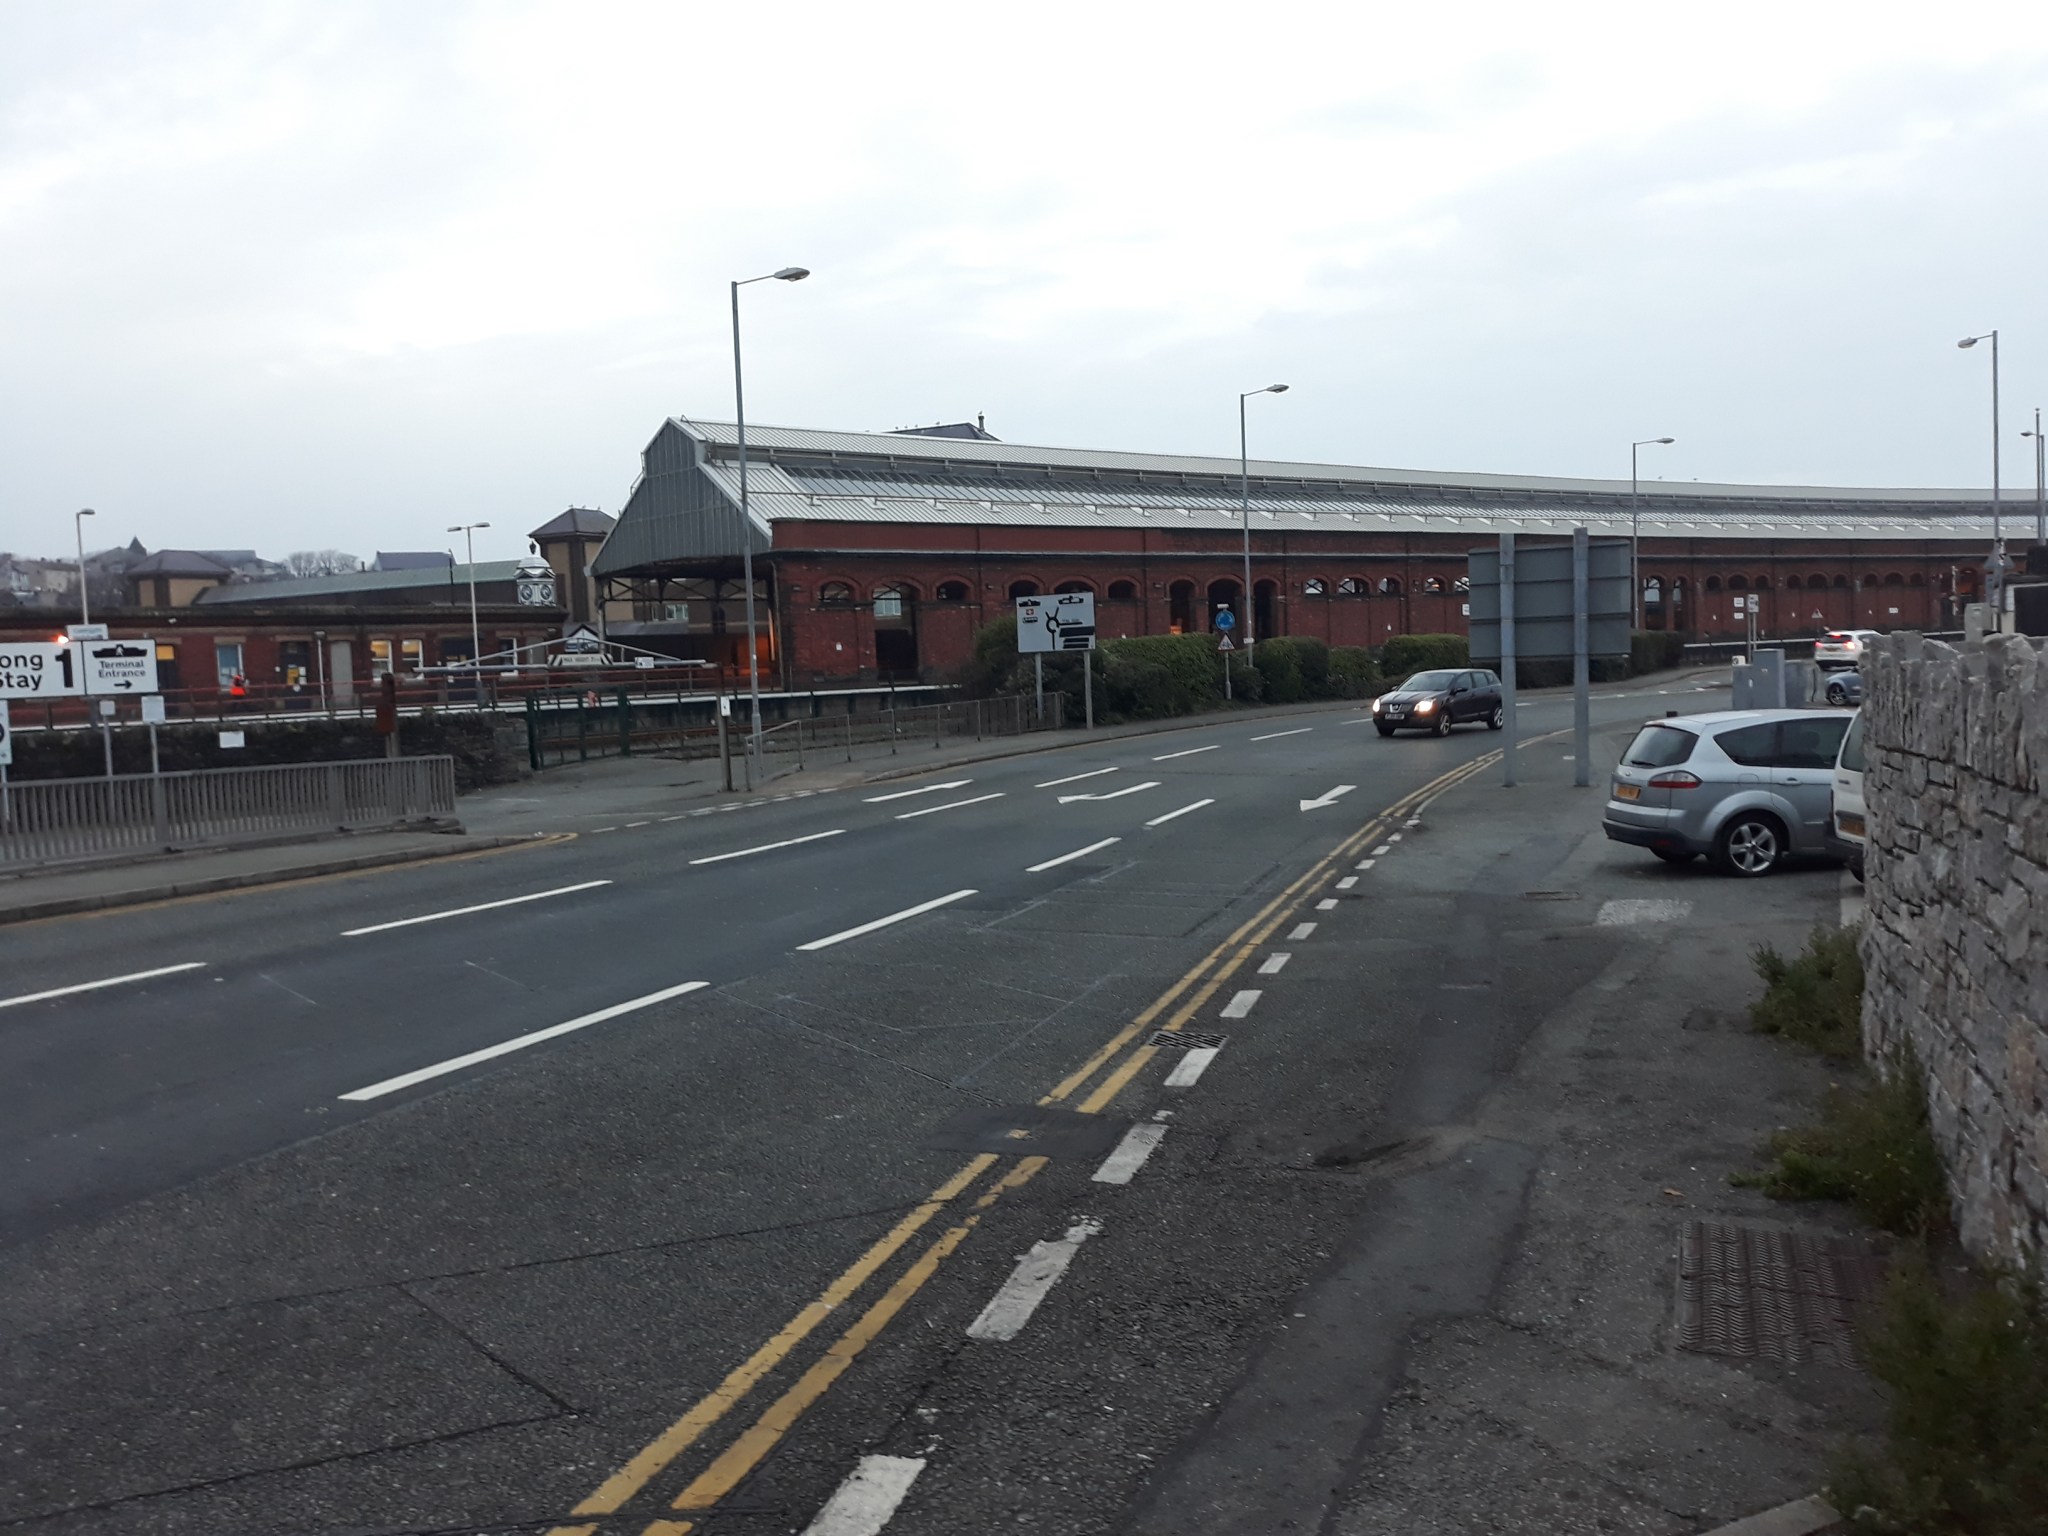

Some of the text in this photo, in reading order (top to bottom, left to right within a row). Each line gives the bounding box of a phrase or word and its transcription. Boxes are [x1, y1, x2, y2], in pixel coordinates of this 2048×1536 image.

[55, 649, 74, 688] 1
[99, 660, 144, 669] Terminal
[99, 669, 146, 678] Entrance
